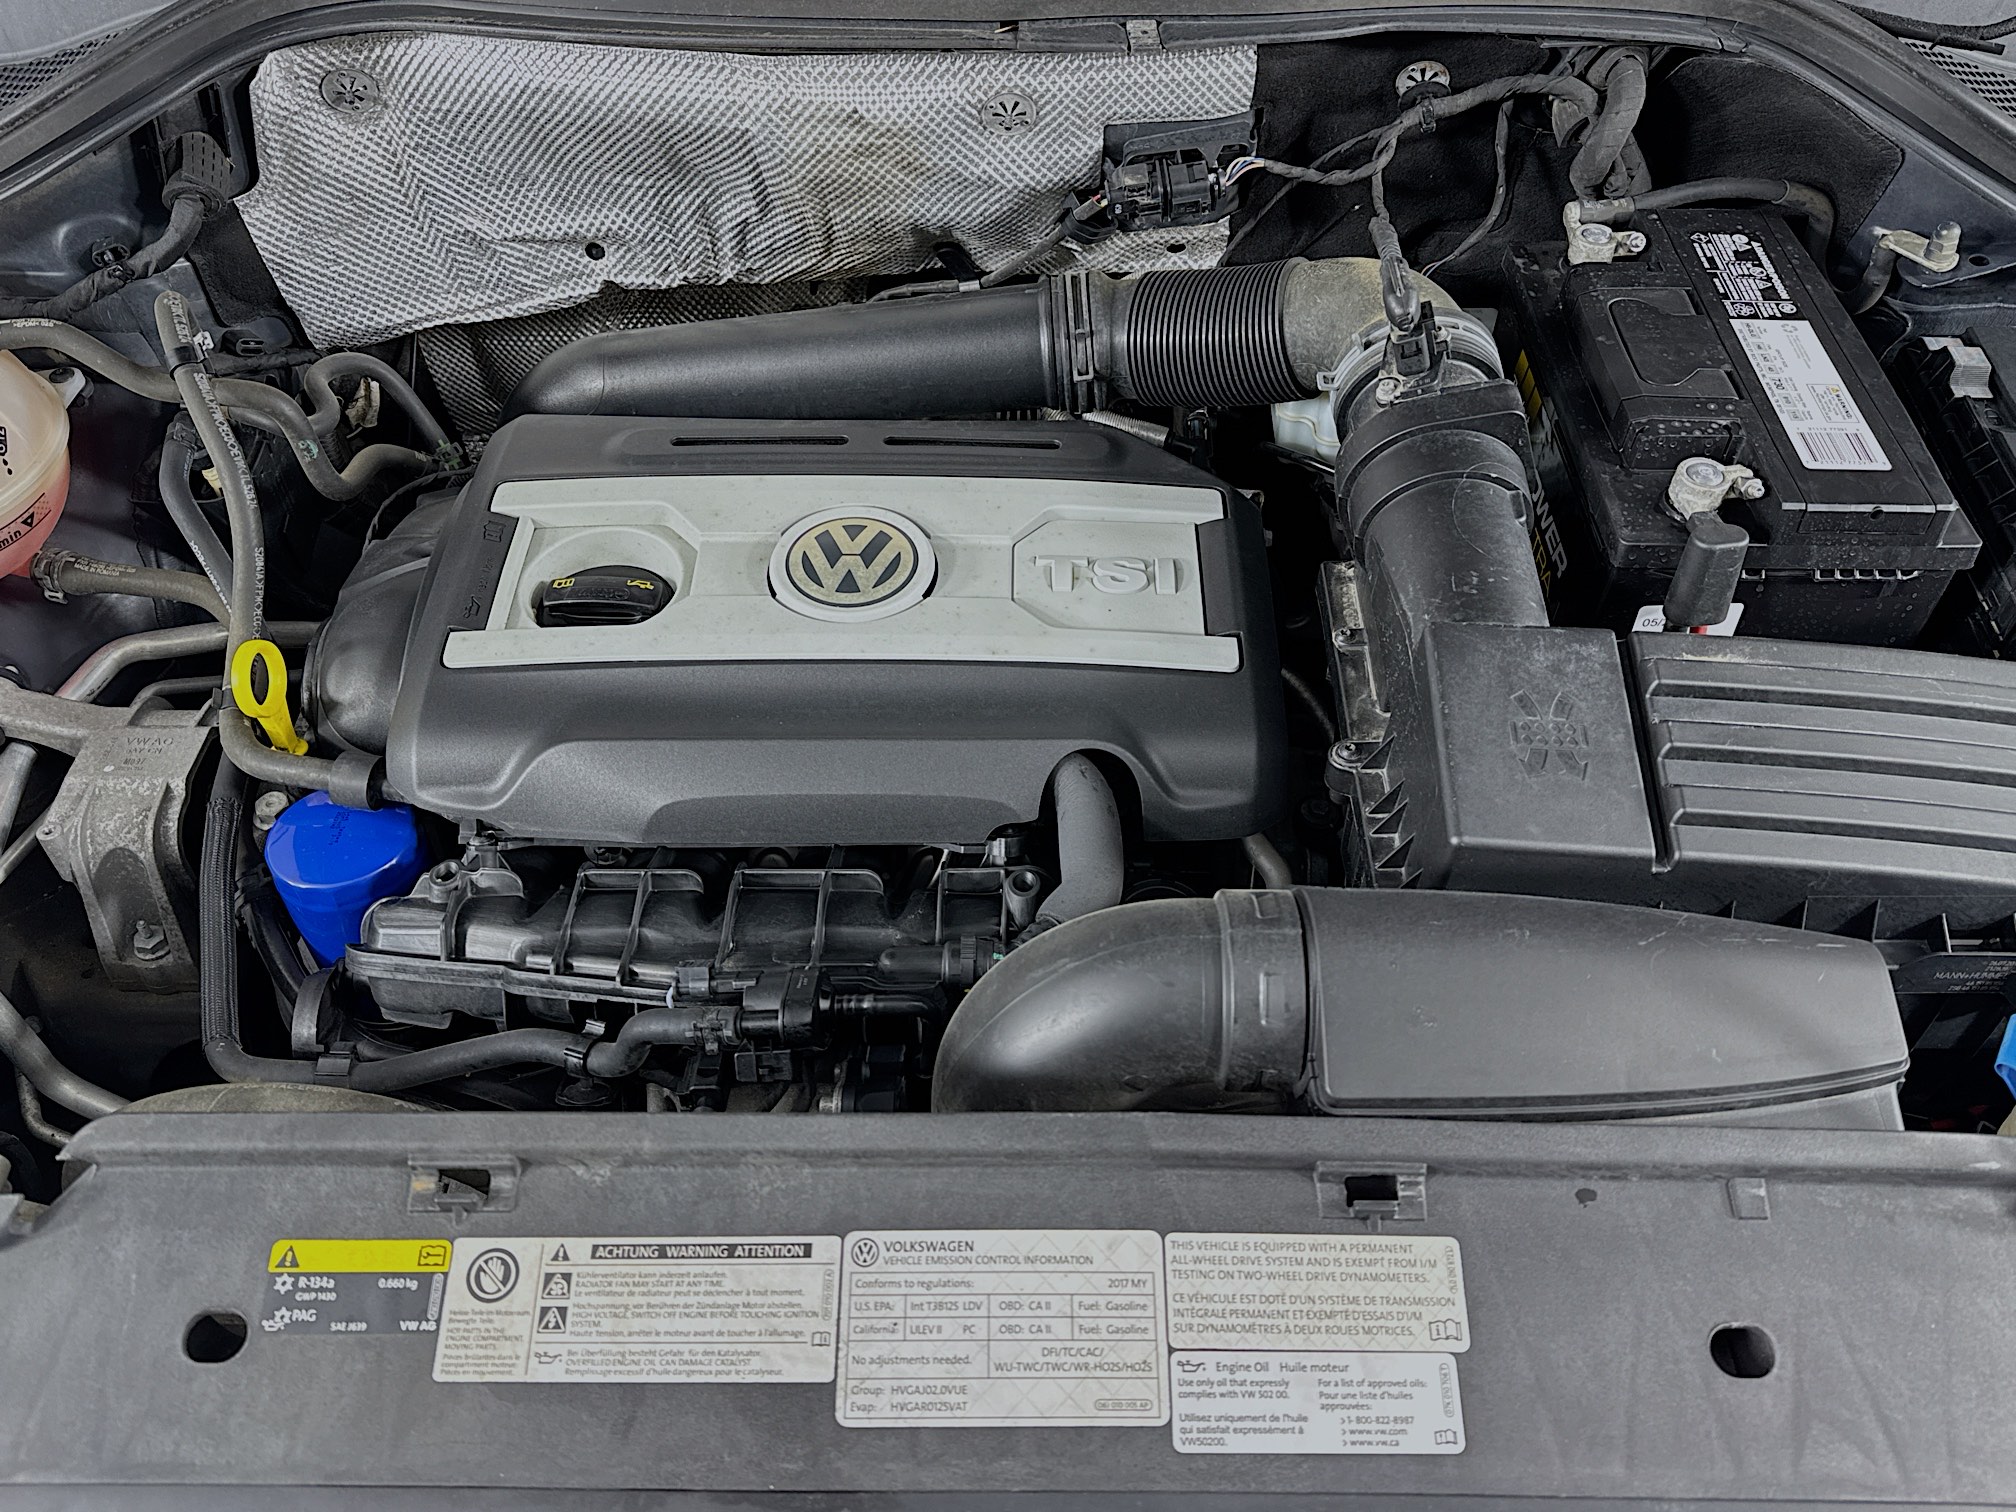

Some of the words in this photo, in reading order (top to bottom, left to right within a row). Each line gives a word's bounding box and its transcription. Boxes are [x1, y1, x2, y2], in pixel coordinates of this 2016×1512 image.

[1770, 378, 1786, 390] 730
[0, 529, 22, 549] min
[1034, 553, 1182, 595] TSI
[595, 1245, 659, 1257] ACHTUNG
[665, 1245, 729, 1257] WARNING
[734, 1244, 805, 1256] ATTENTION
[883, 1240, 975, 1253] VOLKSWAGEN
[1170, 1240, 1194, 1251] THIS
[1196, 1241, 1239, 1251] VEHICLE
[1241, 1241, 1251, 1251] IS
[1253, 1242, 1306, 1253] EQUIPPED
[1308, 1243, 1337, 1252] WITH
[1340, 1243, 1347, 1252] A
[1349, 1243, 1413, 1254] PERMANENT
[882, 1255, 922, 1265] VEHICLE
[925, 1255, 973, 1265] EMISSION
[975, 1255, 1021, 1265] CONTROL
[1024, 1255, 1094, 1265] INFORMATION
[1170, 1255, 1230, 1265] ALL-WHEEL
[1231, 1256, 1263, 1266] DRIVE
[1265, 1256, 1304, 1267] SYSTEM
[1306, 1257, 1331, 1267] AND
[1333, 1258, 1343, 1267] IS
[1387, 1258, 1417, 1268] FROM
[1419, 1259, 1437, 1269] I/M
[1171, 1269, 1215, 1280] TESTING
[1217, 1270, 1234, 1280] ON
[1236, 1270, 1304, 1281] TWO-WHEEL
[1305, 1272, 1337, 1282] DRIVE
[1340, 1272, 1430, 1283] DYNAMOMETERS.
[298, 1276, 335, 1289] R-134a
[378, 1278, 404, 1288] 0.660
[405, 1278, 418, 1291] kg
[575, 1280, 613, 1288] RADIATOR
[615, 1280, 630, 1288] FAN
[632, 1280, 650, 1288] MAY
[651, 1280, 674, 1288] START
[675, 1280, 684, 1288] AT
[686, 1280, 701, 1288] ANY
[855, 1279, 902, 1289] Conforms
[904, 1279, 915, 1288] to
[917, 1279, 975, 1292] regulations:
[1107, 1278, 1129, 1288] 2017
[1131, 1278, 1148, 1288] MY
[854, 1301, 872, 1311] U.S.
[874, 1301, 895, 1311] EPA:
[962, 1301, 983, 1311] LDV
[999, 1301, 1024, 1311] OBD:
[1028, 1301, 1043, 1311] CA
[1078, 1301, 1102, 1311] Fuel:
[1105, 1301, 1148, 1311] Gasoline
[1172, 1293, 1185, 1303] CE
[1240, 1294, 1256, 1304] EST
[1363, 1296, 1378, 1306] DE
[1379, 1296, 1456, 1307] TRANSMISSION
[292, 1309, 317, 1321] PAG
[400, 1321, 419, 1331] VW
[420, 1321, 437, 1331] AG
[910, 1325, 935, 1335] ULEV
[962, 1324, 976, 1334] PC
[999, 1324, 1024, 1334] OBD:
[1028, 1324, 1043, 1334] CA
[1079, 1324, 1102, 1334] Fuel:
[1106, 1324, 1149, 1334] Gasoline
[1173, 1323, 1195, 1333] SUR
[1293, 1324, 1322, 1335] DEUX
[1325, 1325, 1359, 1335] ROUES
[1361, 1326, 1415, 1336] MOTRICES.
[851, 1355, 866, 1365] No
[868, 1355, 930, 1368] adjustments
[932, 1355, 972, 1365] needed.
[1216, 1361, 1252, 1375] Engine
[1254, 1361, 1269, 1372] Oil
[1280, 1362, 1308, 1372] Huile
[1310, 1363, 1350, 1373] moteur
[1177, 1378, 1194, 1387] Use
[1196, 1378, 1215, 1389] only
[1216, 1378, 1227, 1387] oil
[1229, 1378, 1248, 1387] that
[1249, 1378, 1290, 1389] expressly
[1318, 1378, 1332, 1388] For
[1333, 1380, 1339, 1388] a
[1340, 1378, 1354, 1388] list
[1356, 1378, 1365, 1387] of
[1367, 1378, 1407, 1389] approved
[851, 1385, 885, 1398] Group:
[1178, 1390, 1217, 1401] complies
[1218, 1390, 1238, 1399] with
[1240, 1390, 1256, 1399] VW
[1258, 1390, 1274, 1399] 502
[1319, 1391, 1339, 1400] Pour
[1360, 1391, 1378, 1400] liste
[850, 1402, 877, 1414] Evap:
[1179, 1413, 1212, 1422] Utilisez
[1214, 1413, 1266, 1424] uniquement
[1269, 1413, 1280, 1422] de
[1180, 1425, 1193, 1435] qui
[1196, 1425, 1230, 1434] satisfait
